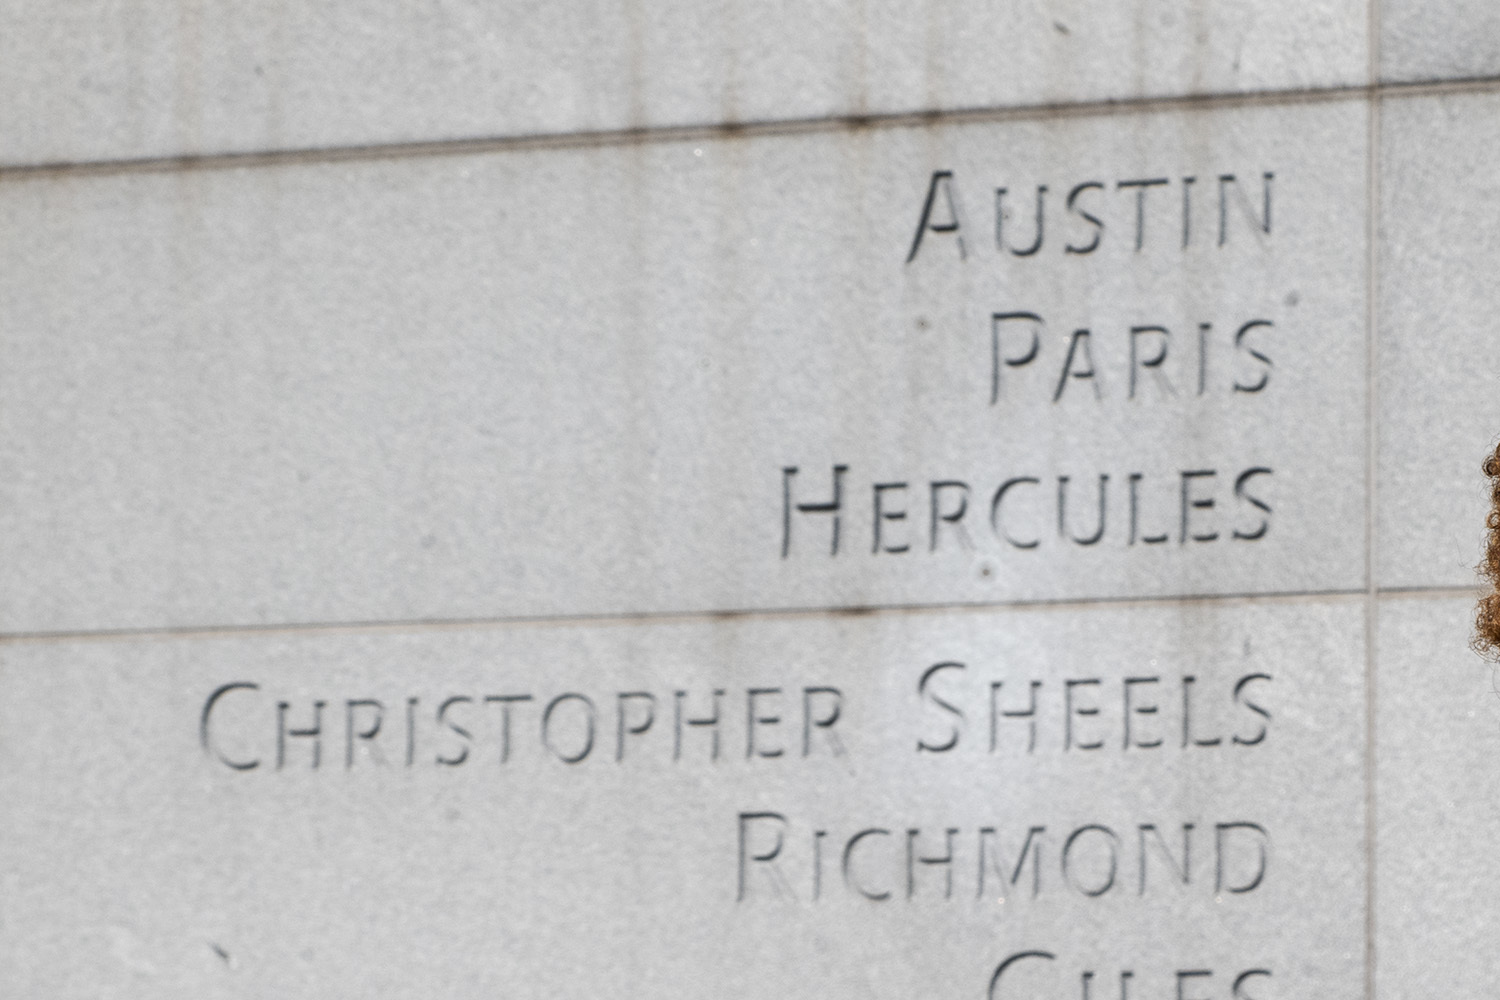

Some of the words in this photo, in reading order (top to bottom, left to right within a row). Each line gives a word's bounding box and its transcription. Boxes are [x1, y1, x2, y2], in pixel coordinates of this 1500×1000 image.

[907, 170, 1274, 263] AUSTIN
[989, 311, 1275, 402] PARIS
[781, 464, 1274, 558] HERCULES
[201, 682, 845, 771] CHRISTOPHER
[916, 661, 1273, 754] SHEELS
[738, 811, 1270, 901] RICHMOND
